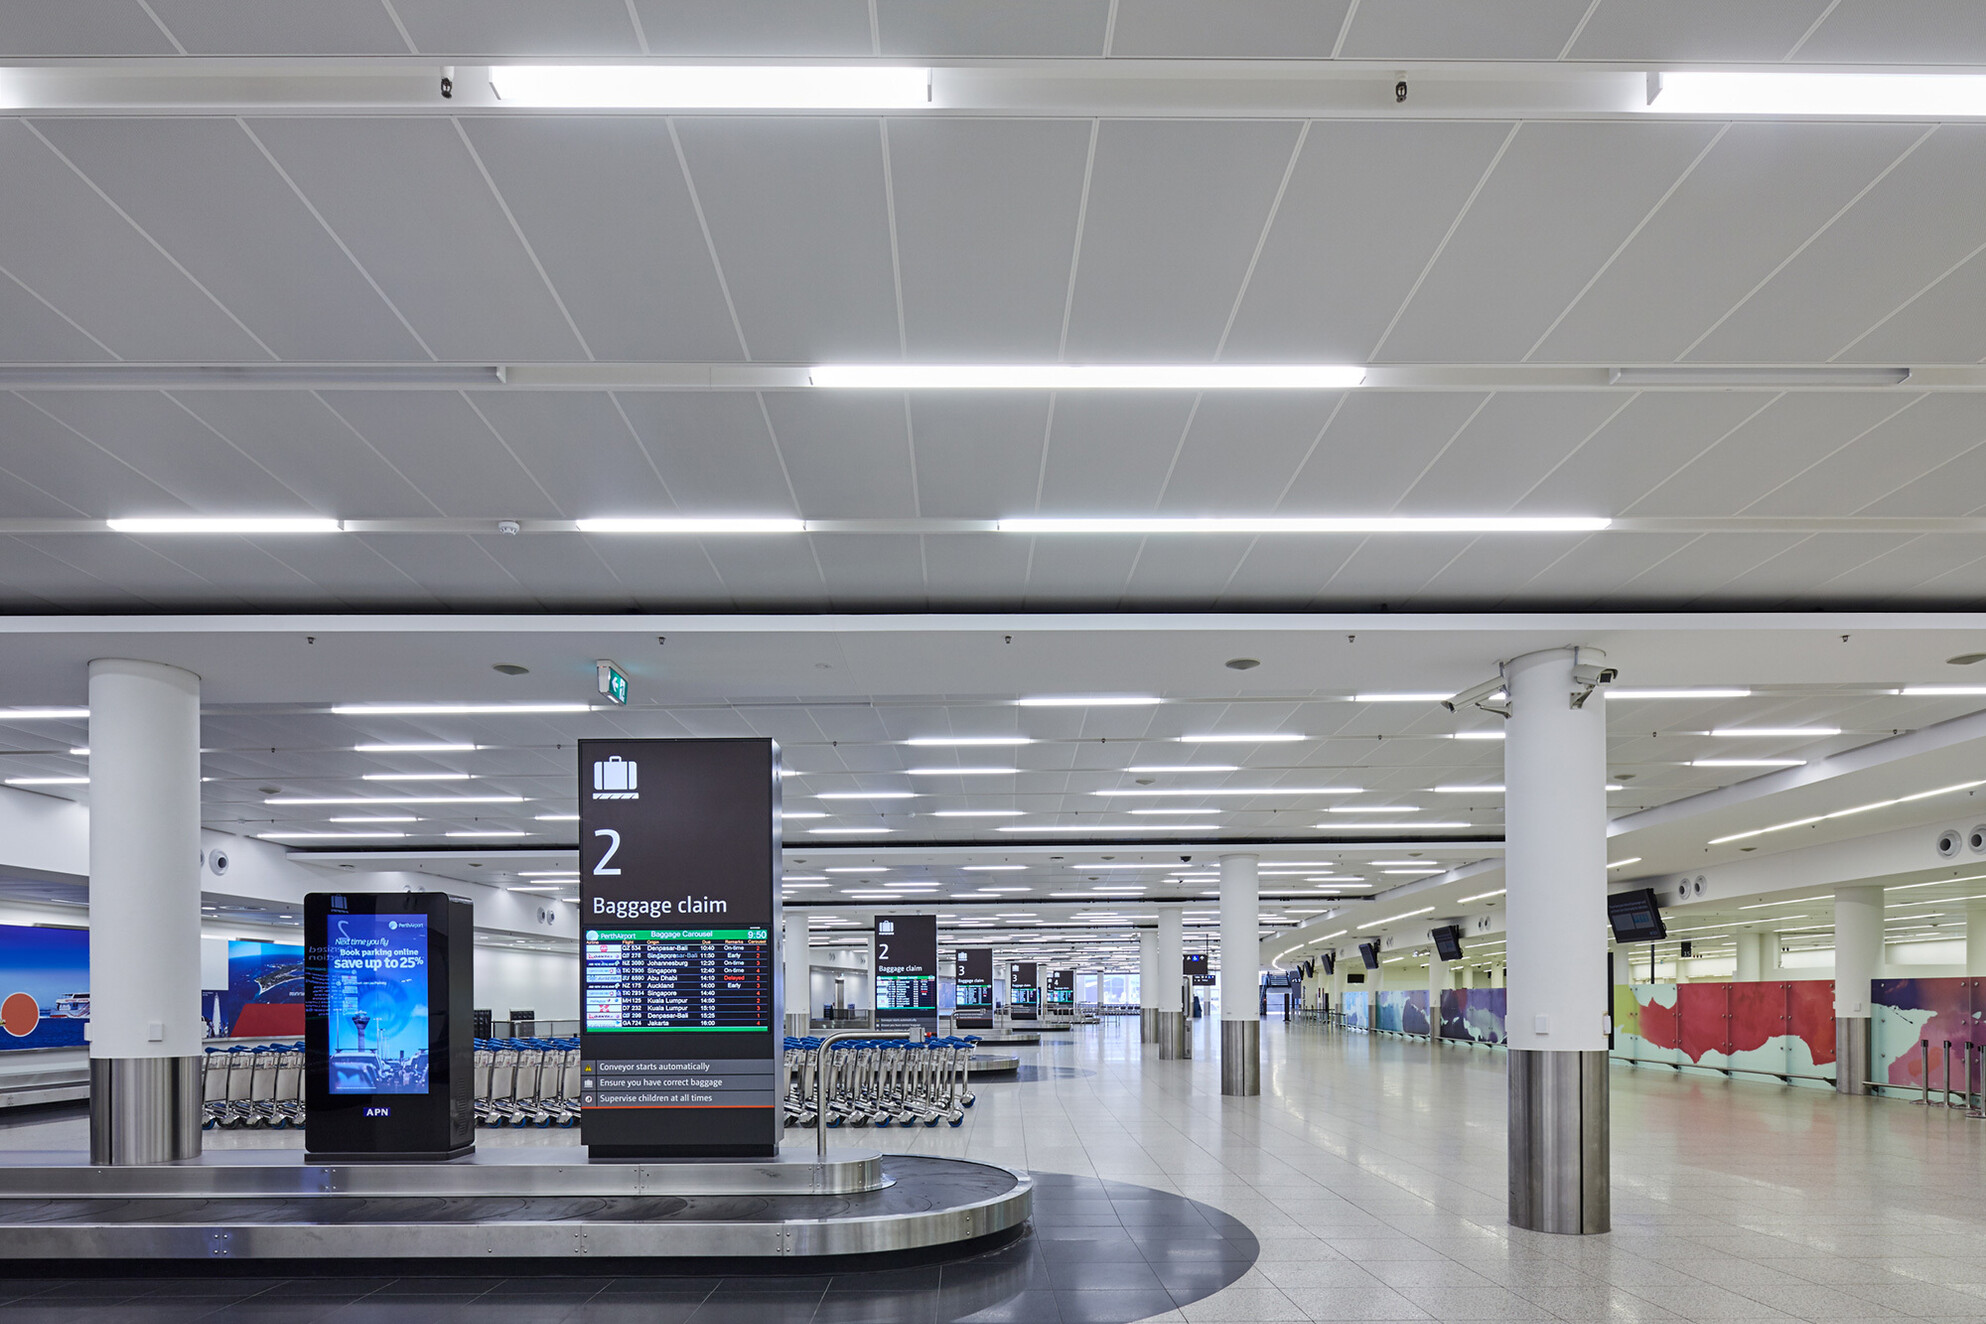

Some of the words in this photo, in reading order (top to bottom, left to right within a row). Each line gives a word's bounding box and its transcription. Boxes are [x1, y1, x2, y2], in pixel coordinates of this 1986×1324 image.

[593, 828, 622, 876] 2
[594, 897, 672, 918] Baggage
[678, 896, 727, 913] claim
[651, 930, 680, 938] Baggage
[380, 938, 389, 947] fly
[362, 948, 392, 957] parking
[878, 944, 889, 960] 2
[334, 959, 363, 968] save
[365, 959, 382, 971] up
[384, 957, 398, 968] to
[400, 957, 424, 968] 25%
[879, 965, 904, 973] Baggage
[958, 966, 965, 976] 3
[600, 1063, 634, 1072] Conveyor
[659, 1062, 710, 1072] automatically
[691, 1079, 722, 1087] baggage
[600, 1094, 637, 1103] Supervise
[638, 1094, 668, 1102] children
